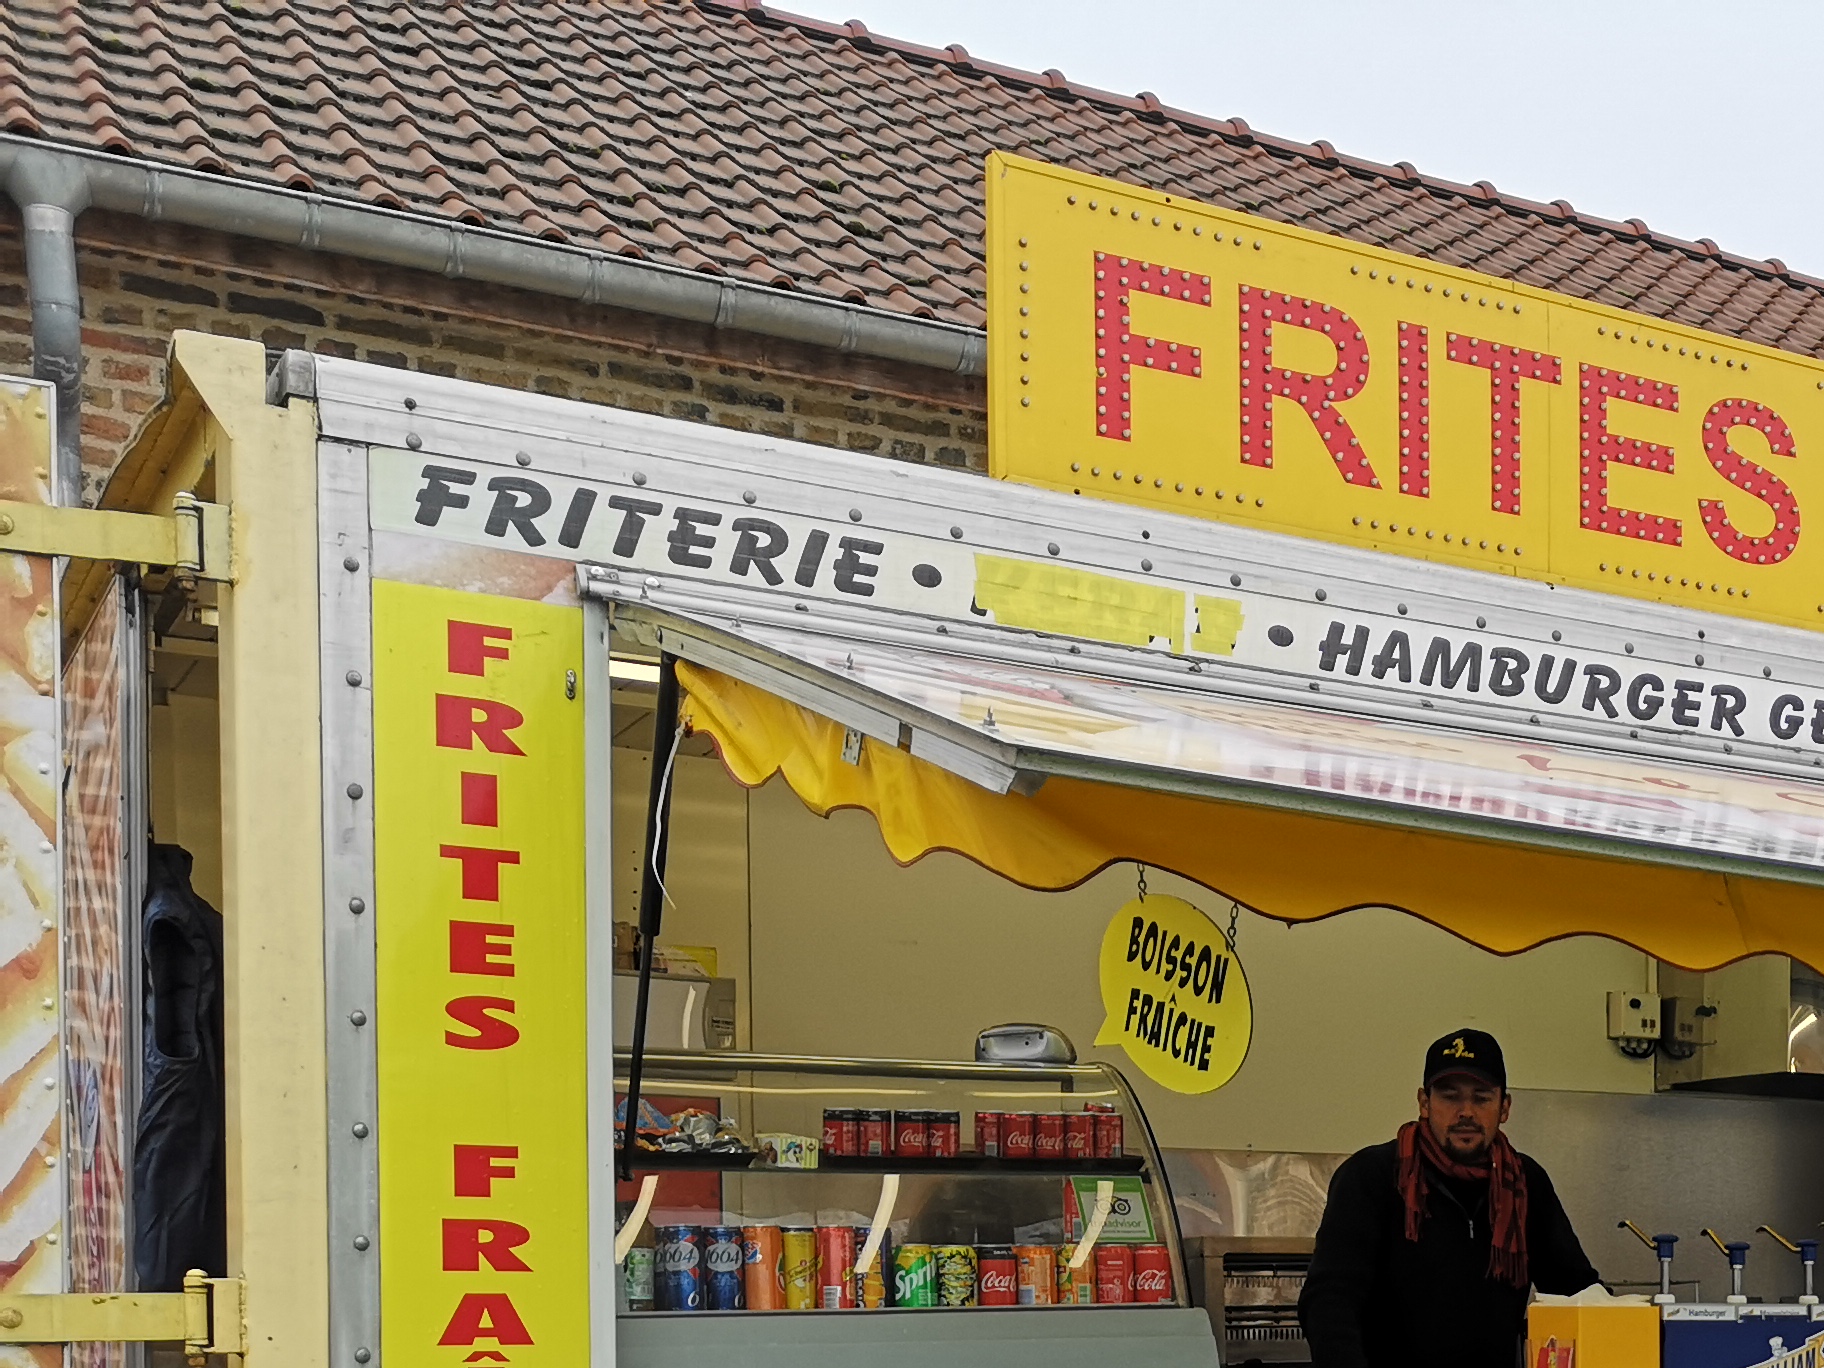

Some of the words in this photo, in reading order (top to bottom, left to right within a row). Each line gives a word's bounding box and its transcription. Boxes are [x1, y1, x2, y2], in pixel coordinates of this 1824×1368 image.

[1094, 250, 1802, 566] FRITES
[414, 464, 885, 598] FRITERIE
[1318, 620, 1747, 739] HAMBURGER
[435, 619, 528, 1051] FRITES
[1127, 916, 1229, 1004] BOISSON
[1124, 988, 1215, 1072] FRAÎCHE
[981, 1270, 1011, 1293] Coca
[1135, 1269, 1167, 1291] Cola
[1687, 1308, 1727, 1319] Hamburger
